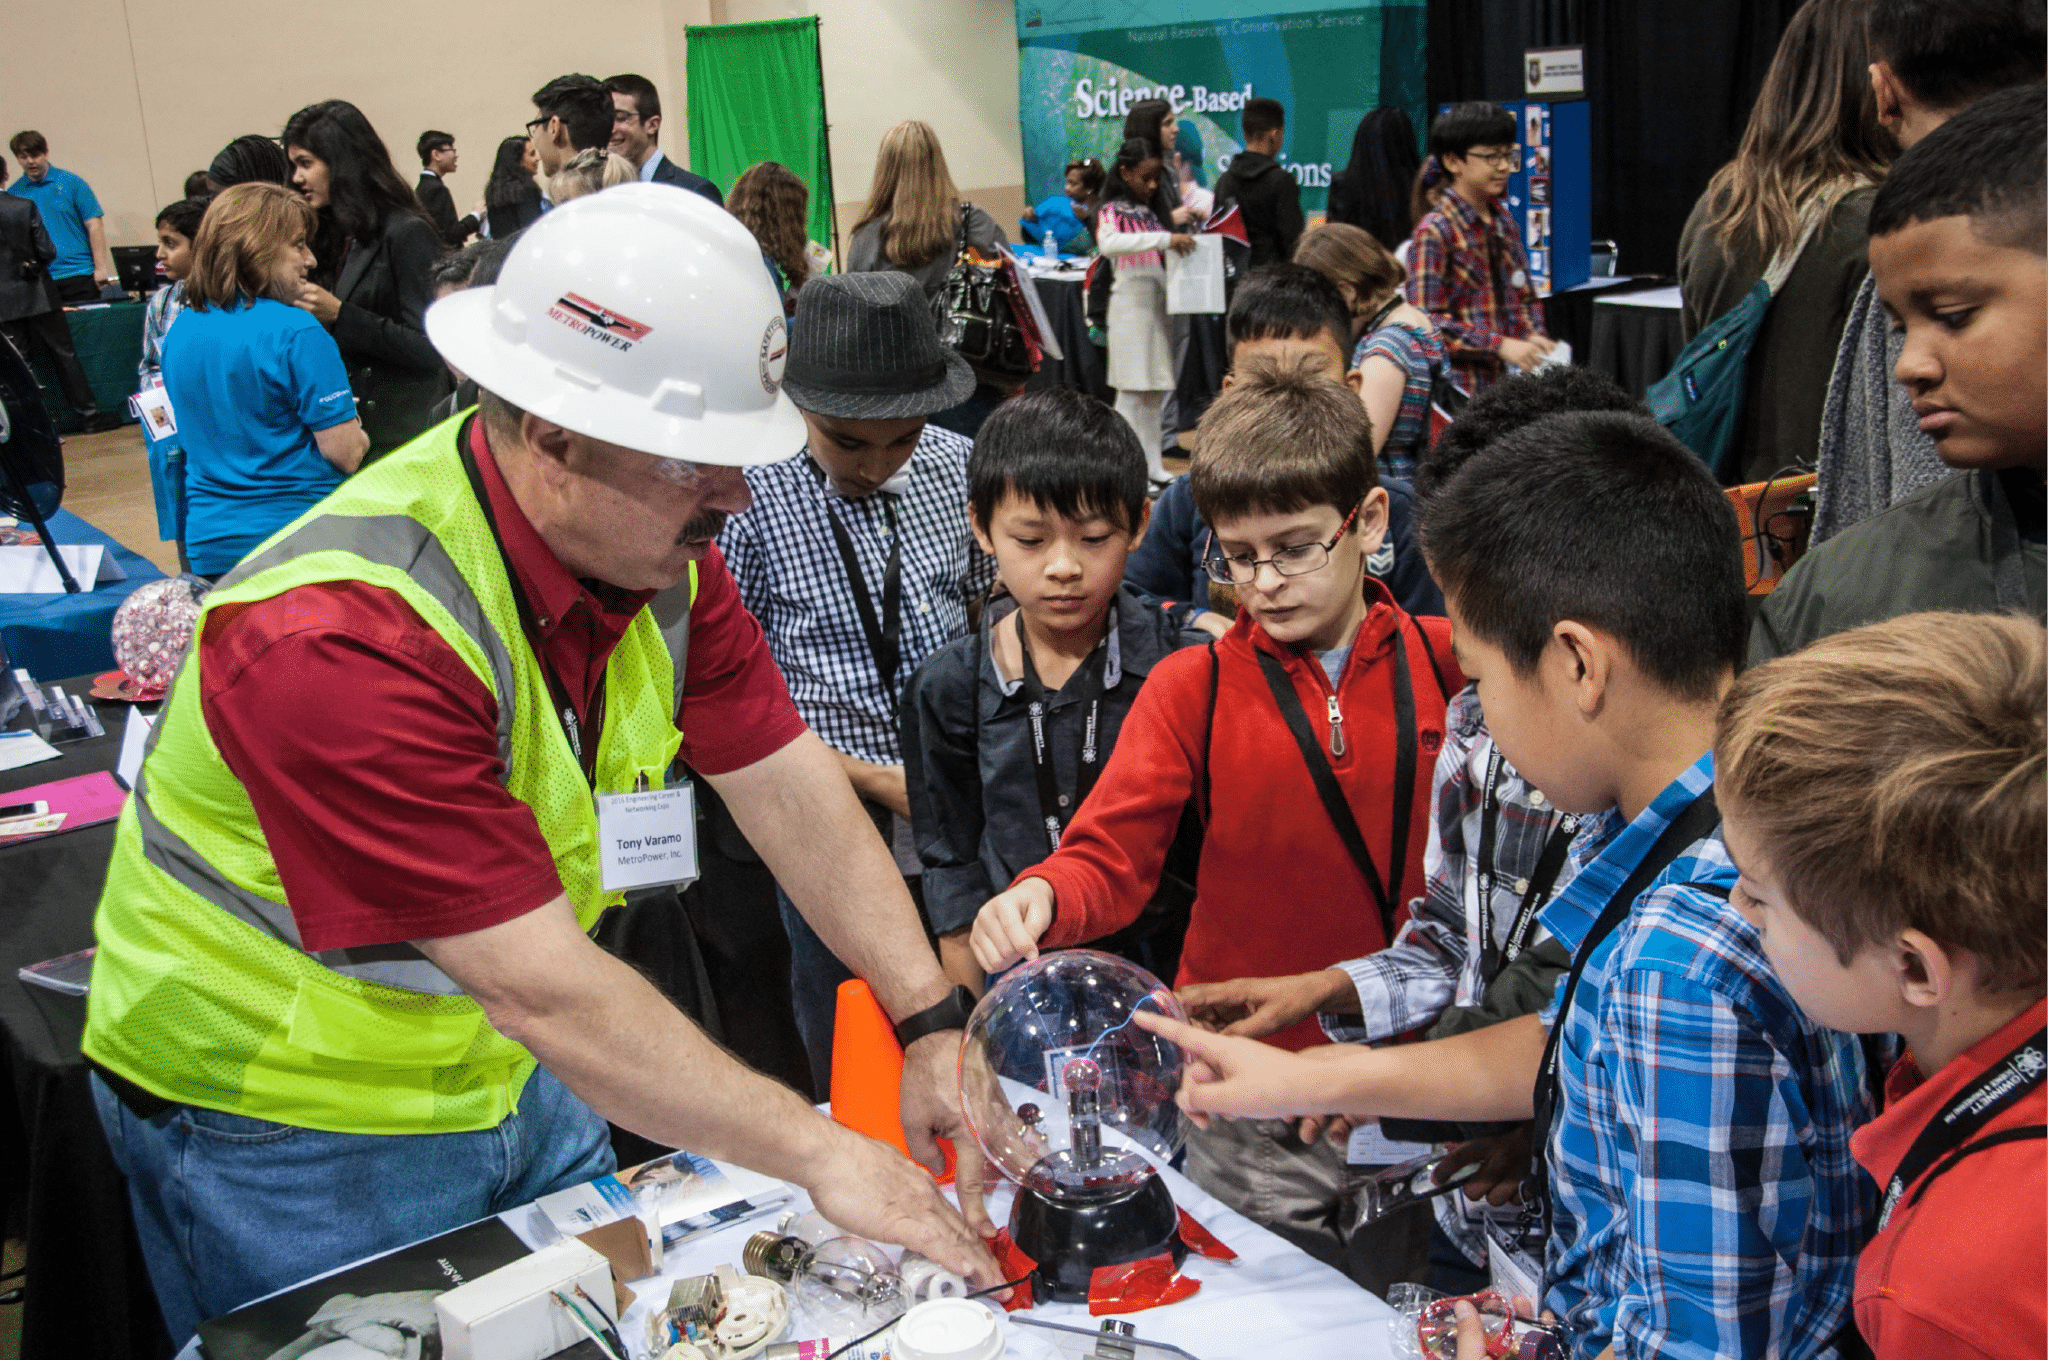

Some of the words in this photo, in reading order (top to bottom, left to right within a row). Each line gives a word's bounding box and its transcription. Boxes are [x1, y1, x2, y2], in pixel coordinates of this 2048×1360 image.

[1128, 27, 1167, 42] Natural
[1171, 24, 1227, 39] Resources
[1232, 18, 1312, 34] Conservation
[1318, 13, 1364, 28] Service
[1217, 152, 1332, 187] Sions
[546, 306, 632, 352] METROPOWER
[616, 839, 642, 850] Tony
[645, 834, 682, 846] Varamo
[618, 852, 669, 865] MetroPower,
[670, 850, 683, 858] Inc.
[1970, 1073, 2021, 1115] GWINNETT
